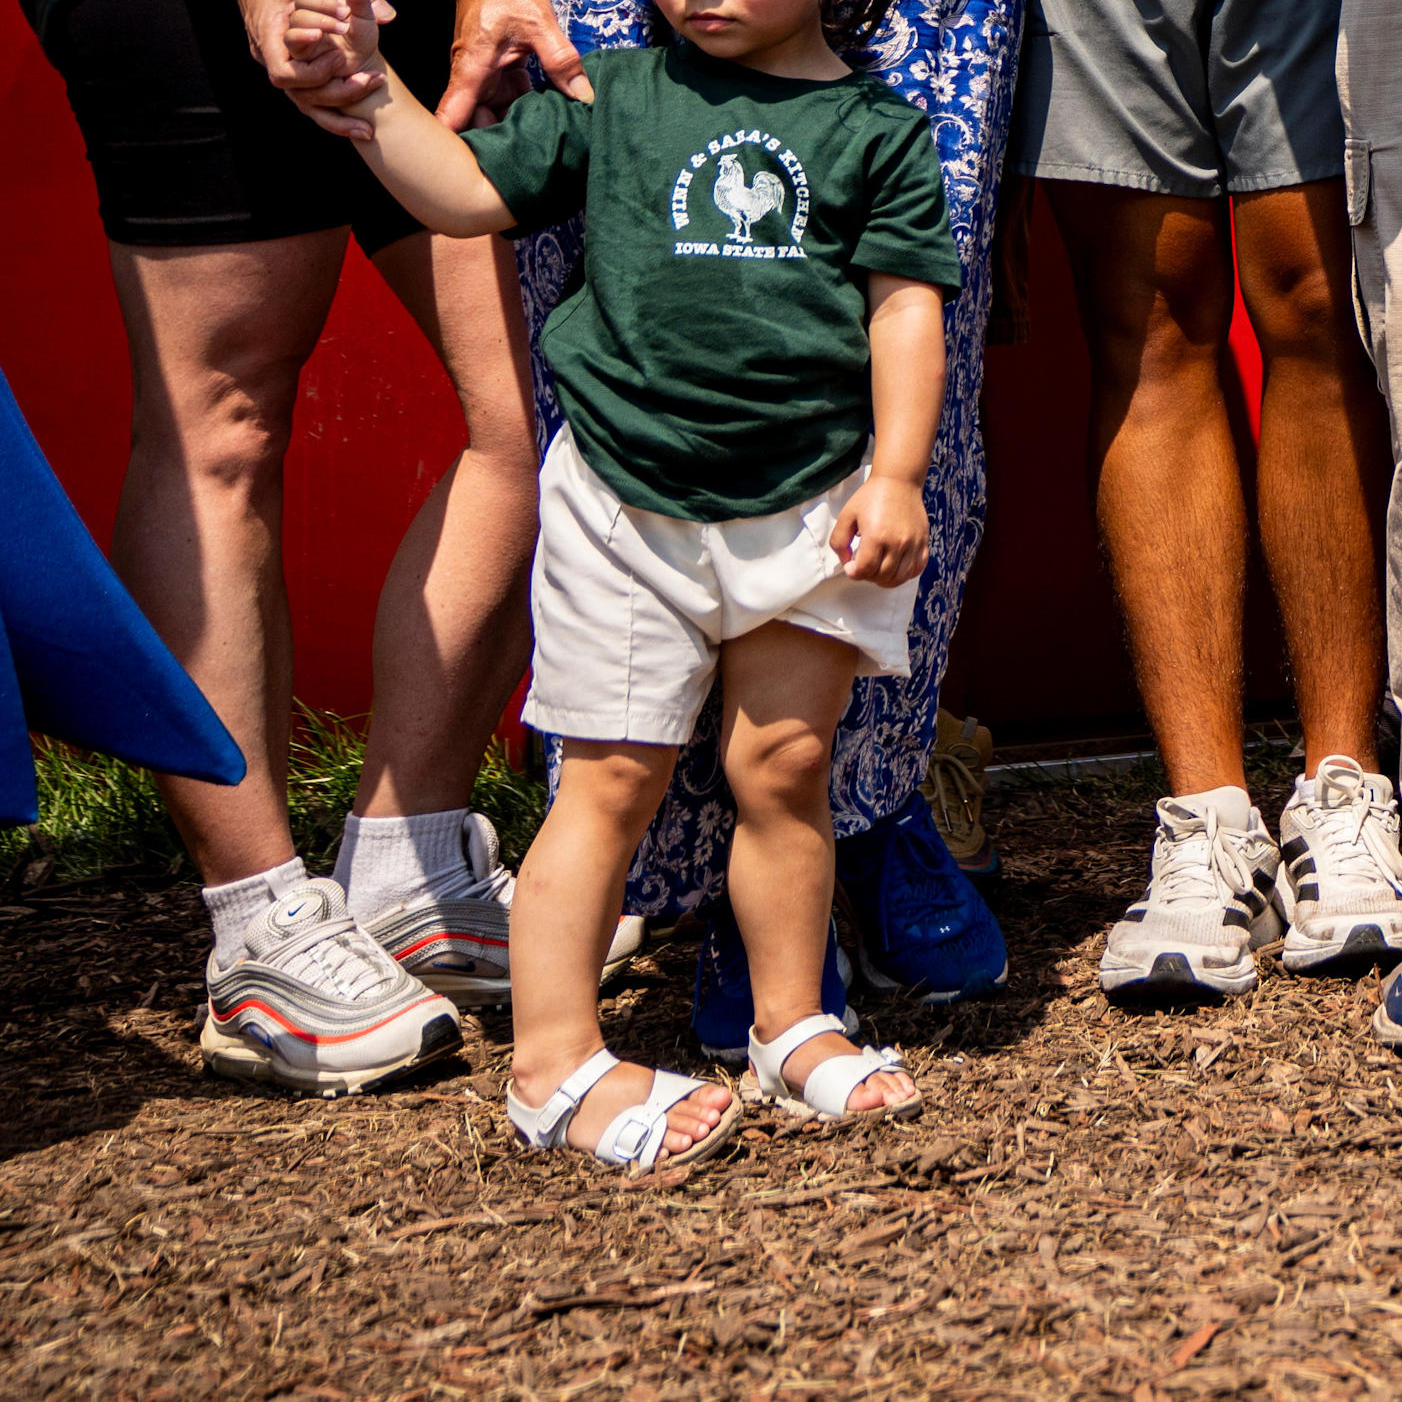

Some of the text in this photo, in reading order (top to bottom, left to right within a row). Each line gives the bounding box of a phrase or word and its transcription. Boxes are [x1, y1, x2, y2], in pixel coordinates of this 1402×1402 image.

[670, 169, 694, 230] WINN
[690, 152, 707, 168] &
[777, 149, 810, 243] KITCHEN
[675, 243, 720, 255] IOWA
[722, 244, 776, 258] STATE
